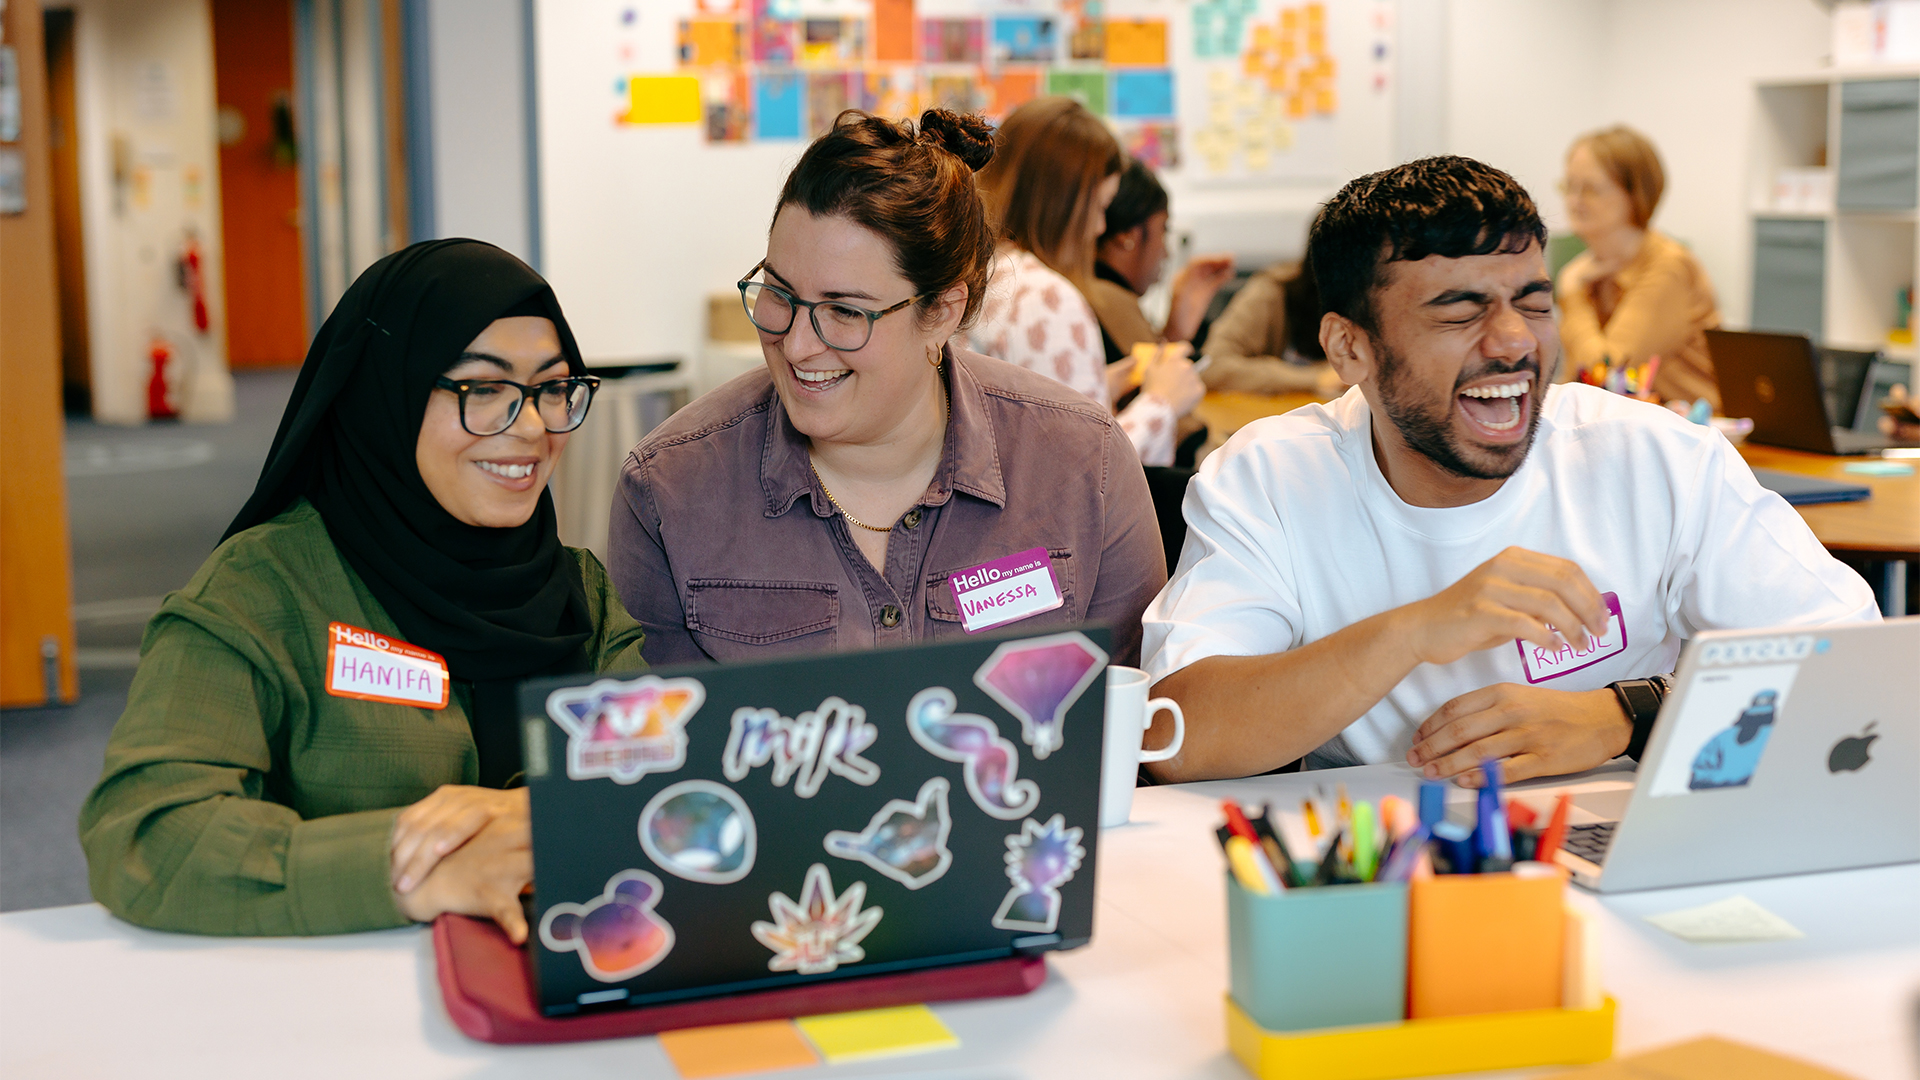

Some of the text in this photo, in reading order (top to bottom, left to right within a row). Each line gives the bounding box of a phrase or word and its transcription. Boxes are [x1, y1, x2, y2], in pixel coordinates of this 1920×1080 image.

[953, 567, 1001, 592] Hello
[1001, 570, 1013, 578] my
[1014, 563, 1034, 574] name
[964, 584, 1037, 616] VANESSA
[336, 625, 390, 650] Hello
[341, 656, 431, 693] HANIFA
